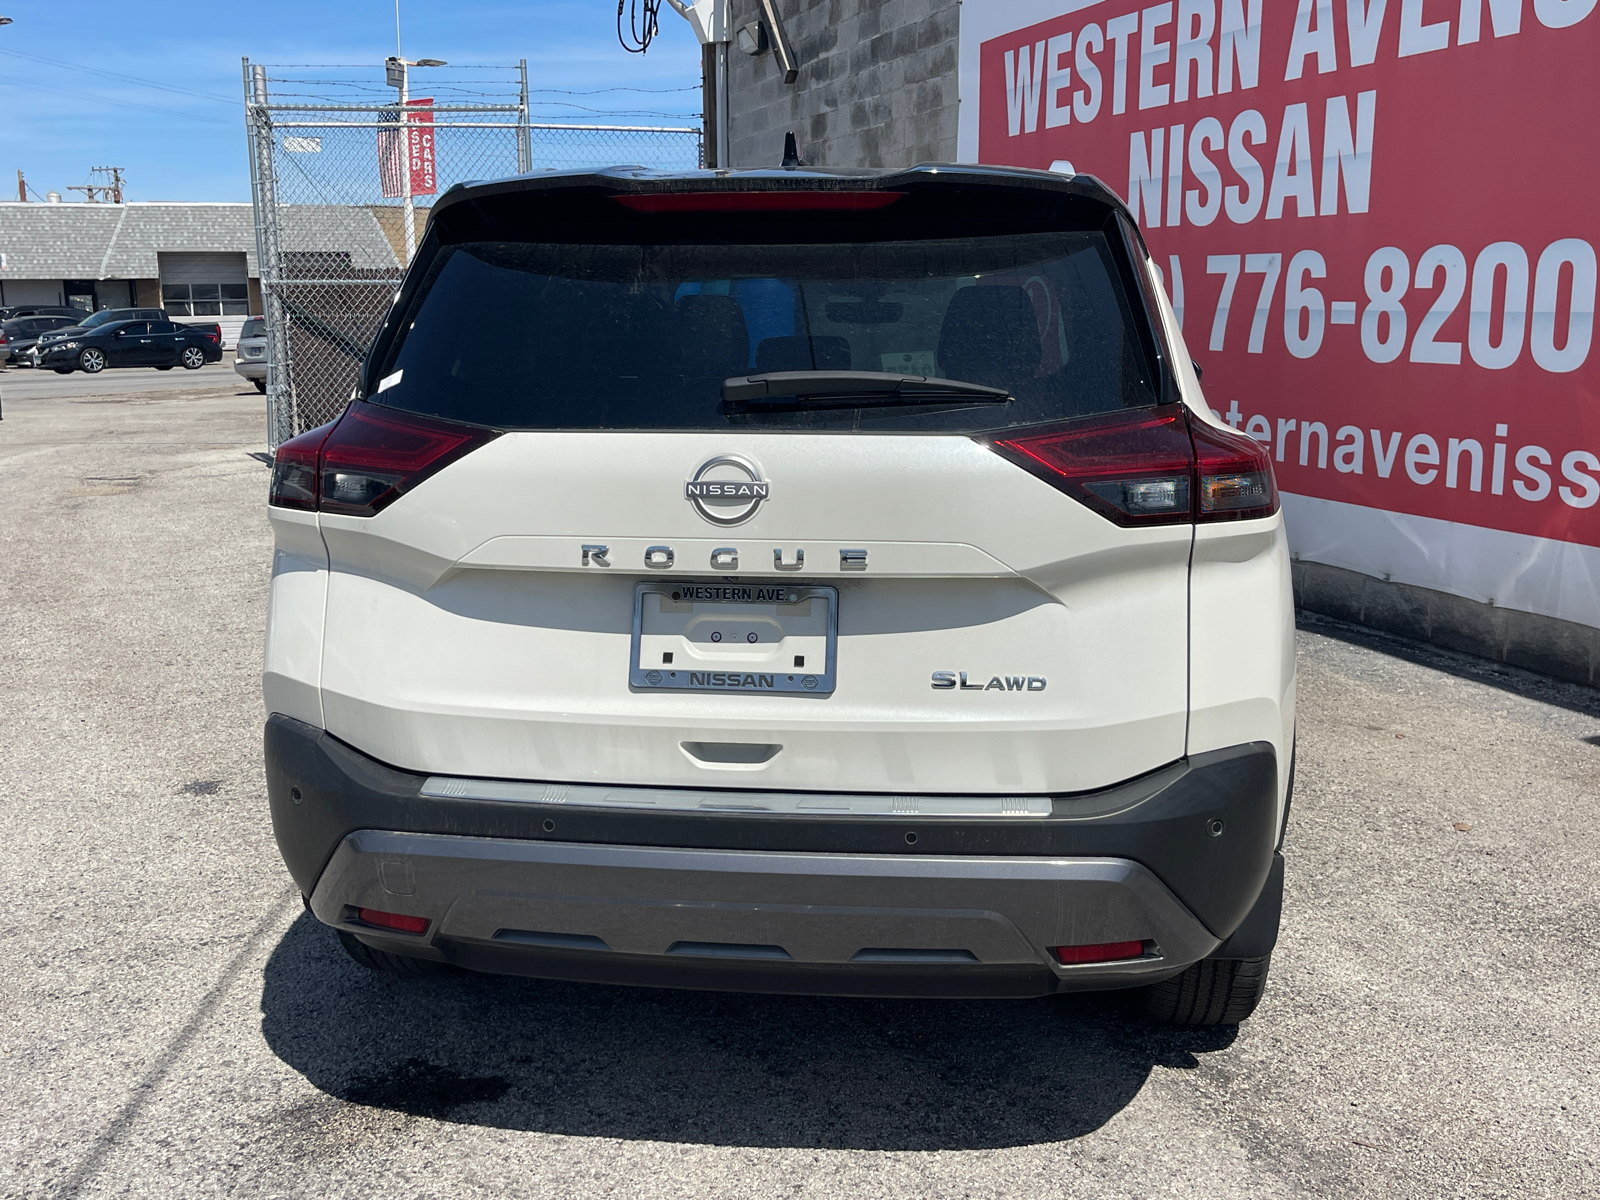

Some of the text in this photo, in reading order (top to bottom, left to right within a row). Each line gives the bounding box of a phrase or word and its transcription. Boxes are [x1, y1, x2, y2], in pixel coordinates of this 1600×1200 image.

[1003, 0, 1263, 137] WESTERN
[410, 117, 421, 171] USED
[422, 134, 434, 188] CARS
[1127, 89, 1377, 228] NISSAN
[1206, 237, 1598, 373] 776-8200
[1211, 400, 1600, 509] ternaveniss
[687, 484, 767, 497] NISSAN
[581, 544, 869, 572] ROGUE
[682, 586, 789, 602] WESTERN AVE.
[688, 672, 775, 688] NISSAN
